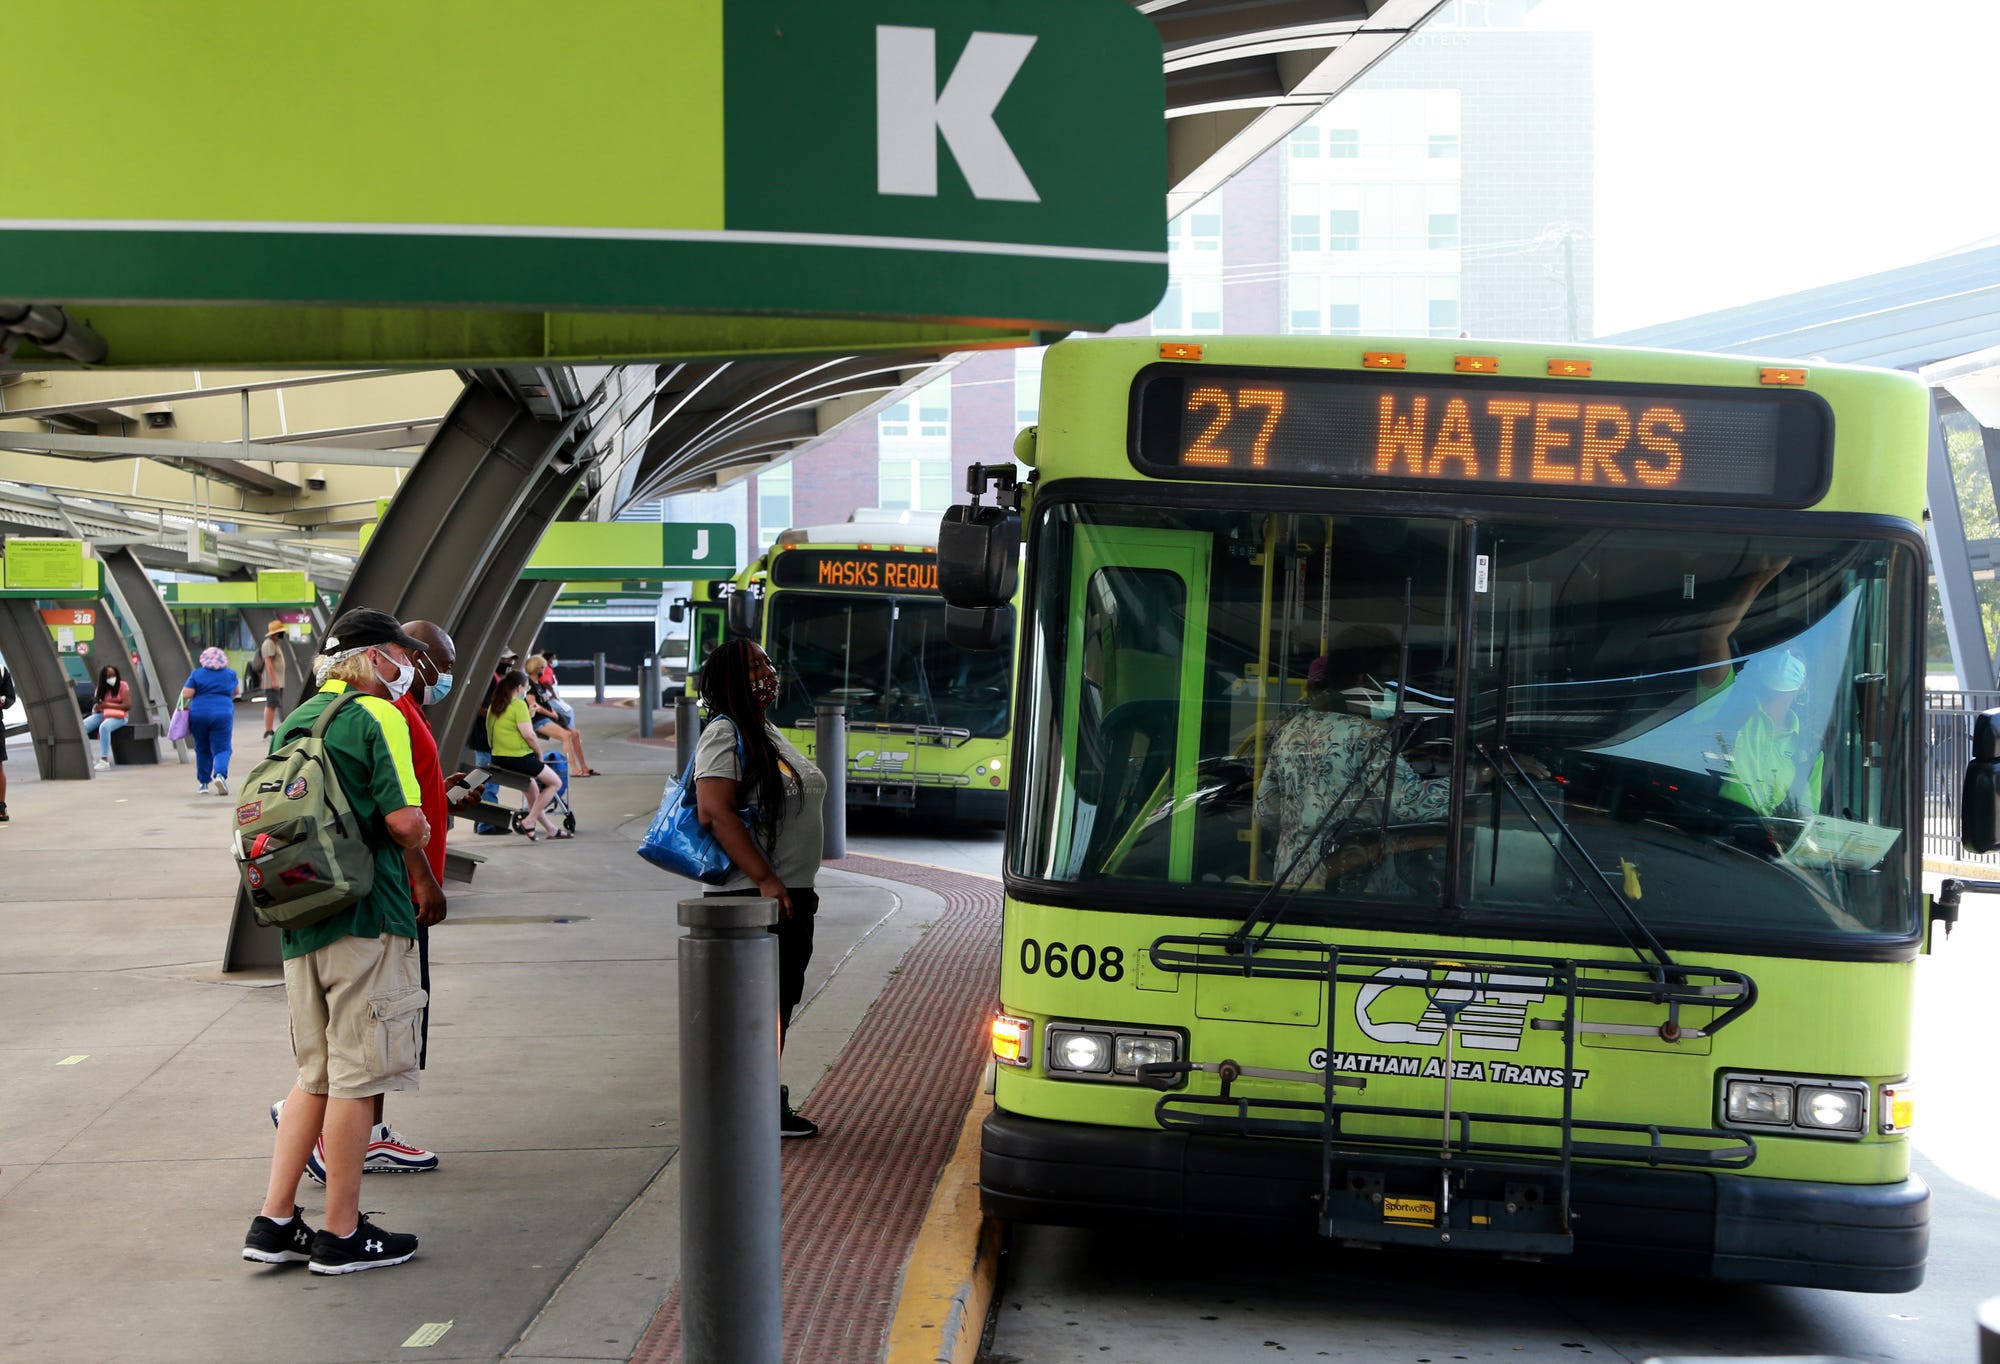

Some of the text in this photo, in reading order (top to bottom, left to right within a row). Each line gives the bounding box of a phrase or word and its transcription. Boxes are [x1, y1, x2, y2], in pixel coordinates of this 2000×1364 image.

[1408, 34, 1471, 46] OTELS
[876, 25, 1041, 202] K
[1184, 387, 1685, 485] 27 WATERS
[692, 529, 709, 560] J
[818, 560, 879, 587] MASKS
[854, 750, 909, 771] CAT
[1020, 938, 1124, 982] 0608
[1354, 966, 1549, 1052] CAT
[1309, 1048, 1589, 1089] CHATHAM AREA TRANST
